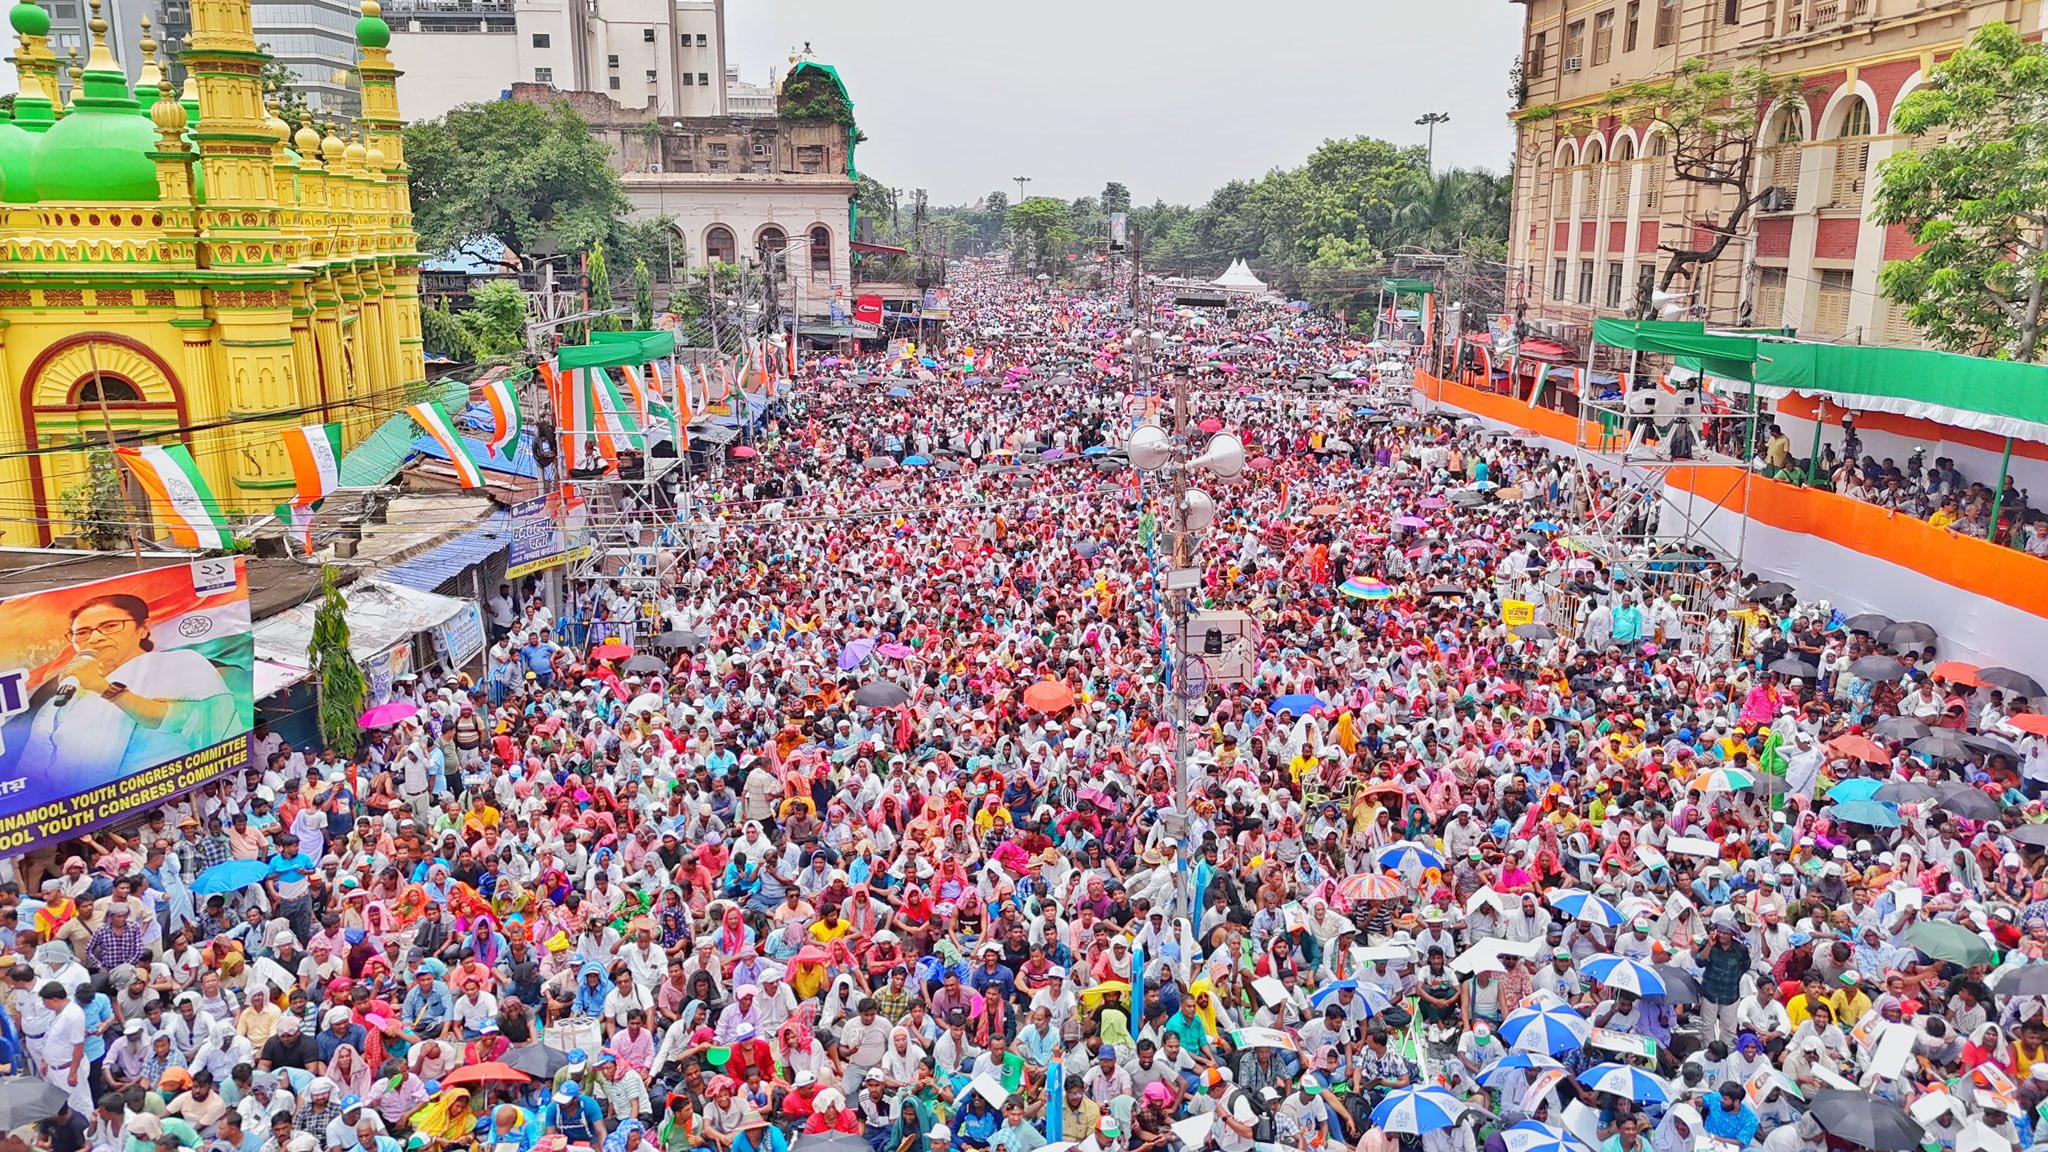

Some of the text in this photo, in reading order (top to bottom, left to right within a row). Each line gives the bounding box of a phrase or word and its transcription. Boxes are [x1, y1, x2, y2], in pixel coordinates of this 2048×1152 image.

[200, 563, 226, 576] ২১
[523, 562, 537, 571] DILIP
[537, 556, 559, 567] SONKAR
[37, 809, 95, 838] YOUTH
[98, 779, 176, 818] CONGRESS
[178, 750, 248, 788] COMMITTEE
[70, 784, 117, 811] YOUTH
[119, 760, 183, 794] CONGRESS
[185, 735, 247, 772] COMMITTEE
